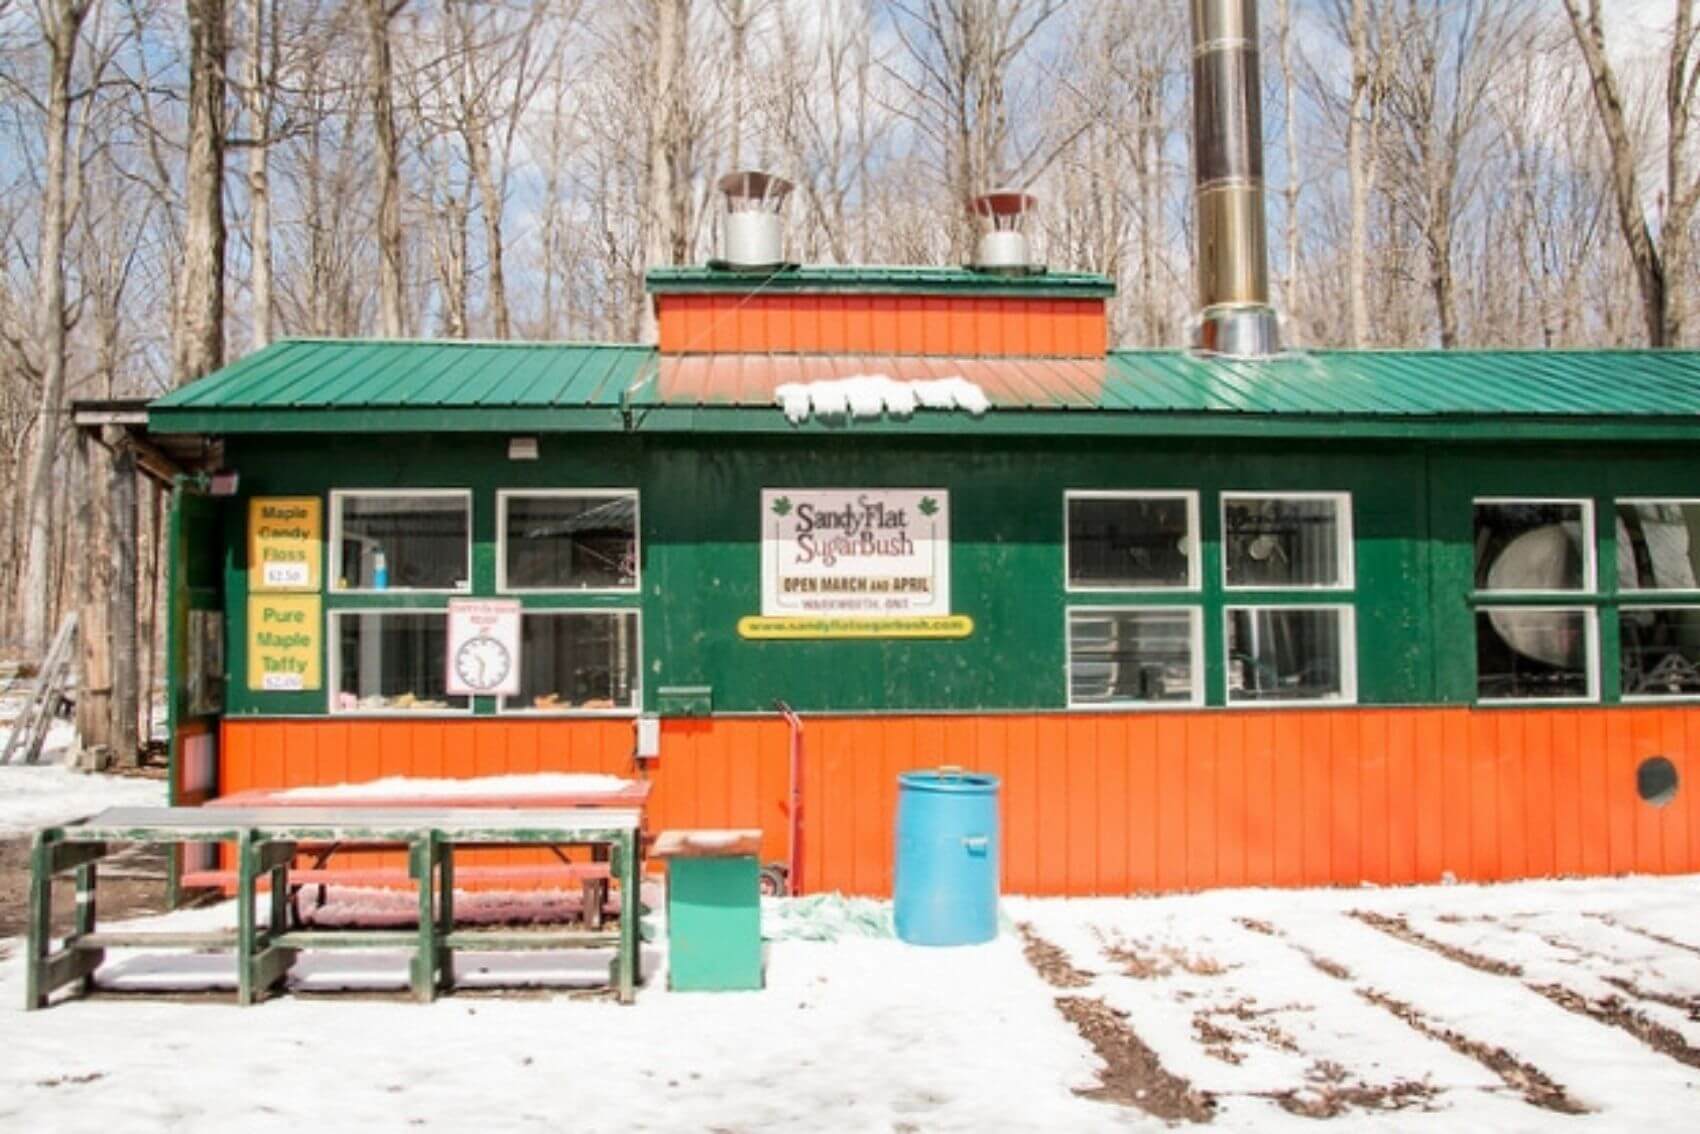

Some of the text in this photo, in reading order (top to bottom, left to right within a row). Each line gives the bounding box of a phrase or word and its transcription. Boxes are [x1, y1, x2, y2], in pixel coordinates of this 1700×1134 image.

[261, 506, 308, 521] Maple
[258, 526, 311, 541] Candy
[263, 547, 306, 561] Floss
[783, 576, 818, 593] OPEN
[820, 576, 868, 593] MARCH
[893, 576, 930, 593] APRIL
[263, 608, 305, 623] Pure
[257, 631, 311, 650] Maple
[262, 656, 308, 674] Taffy
